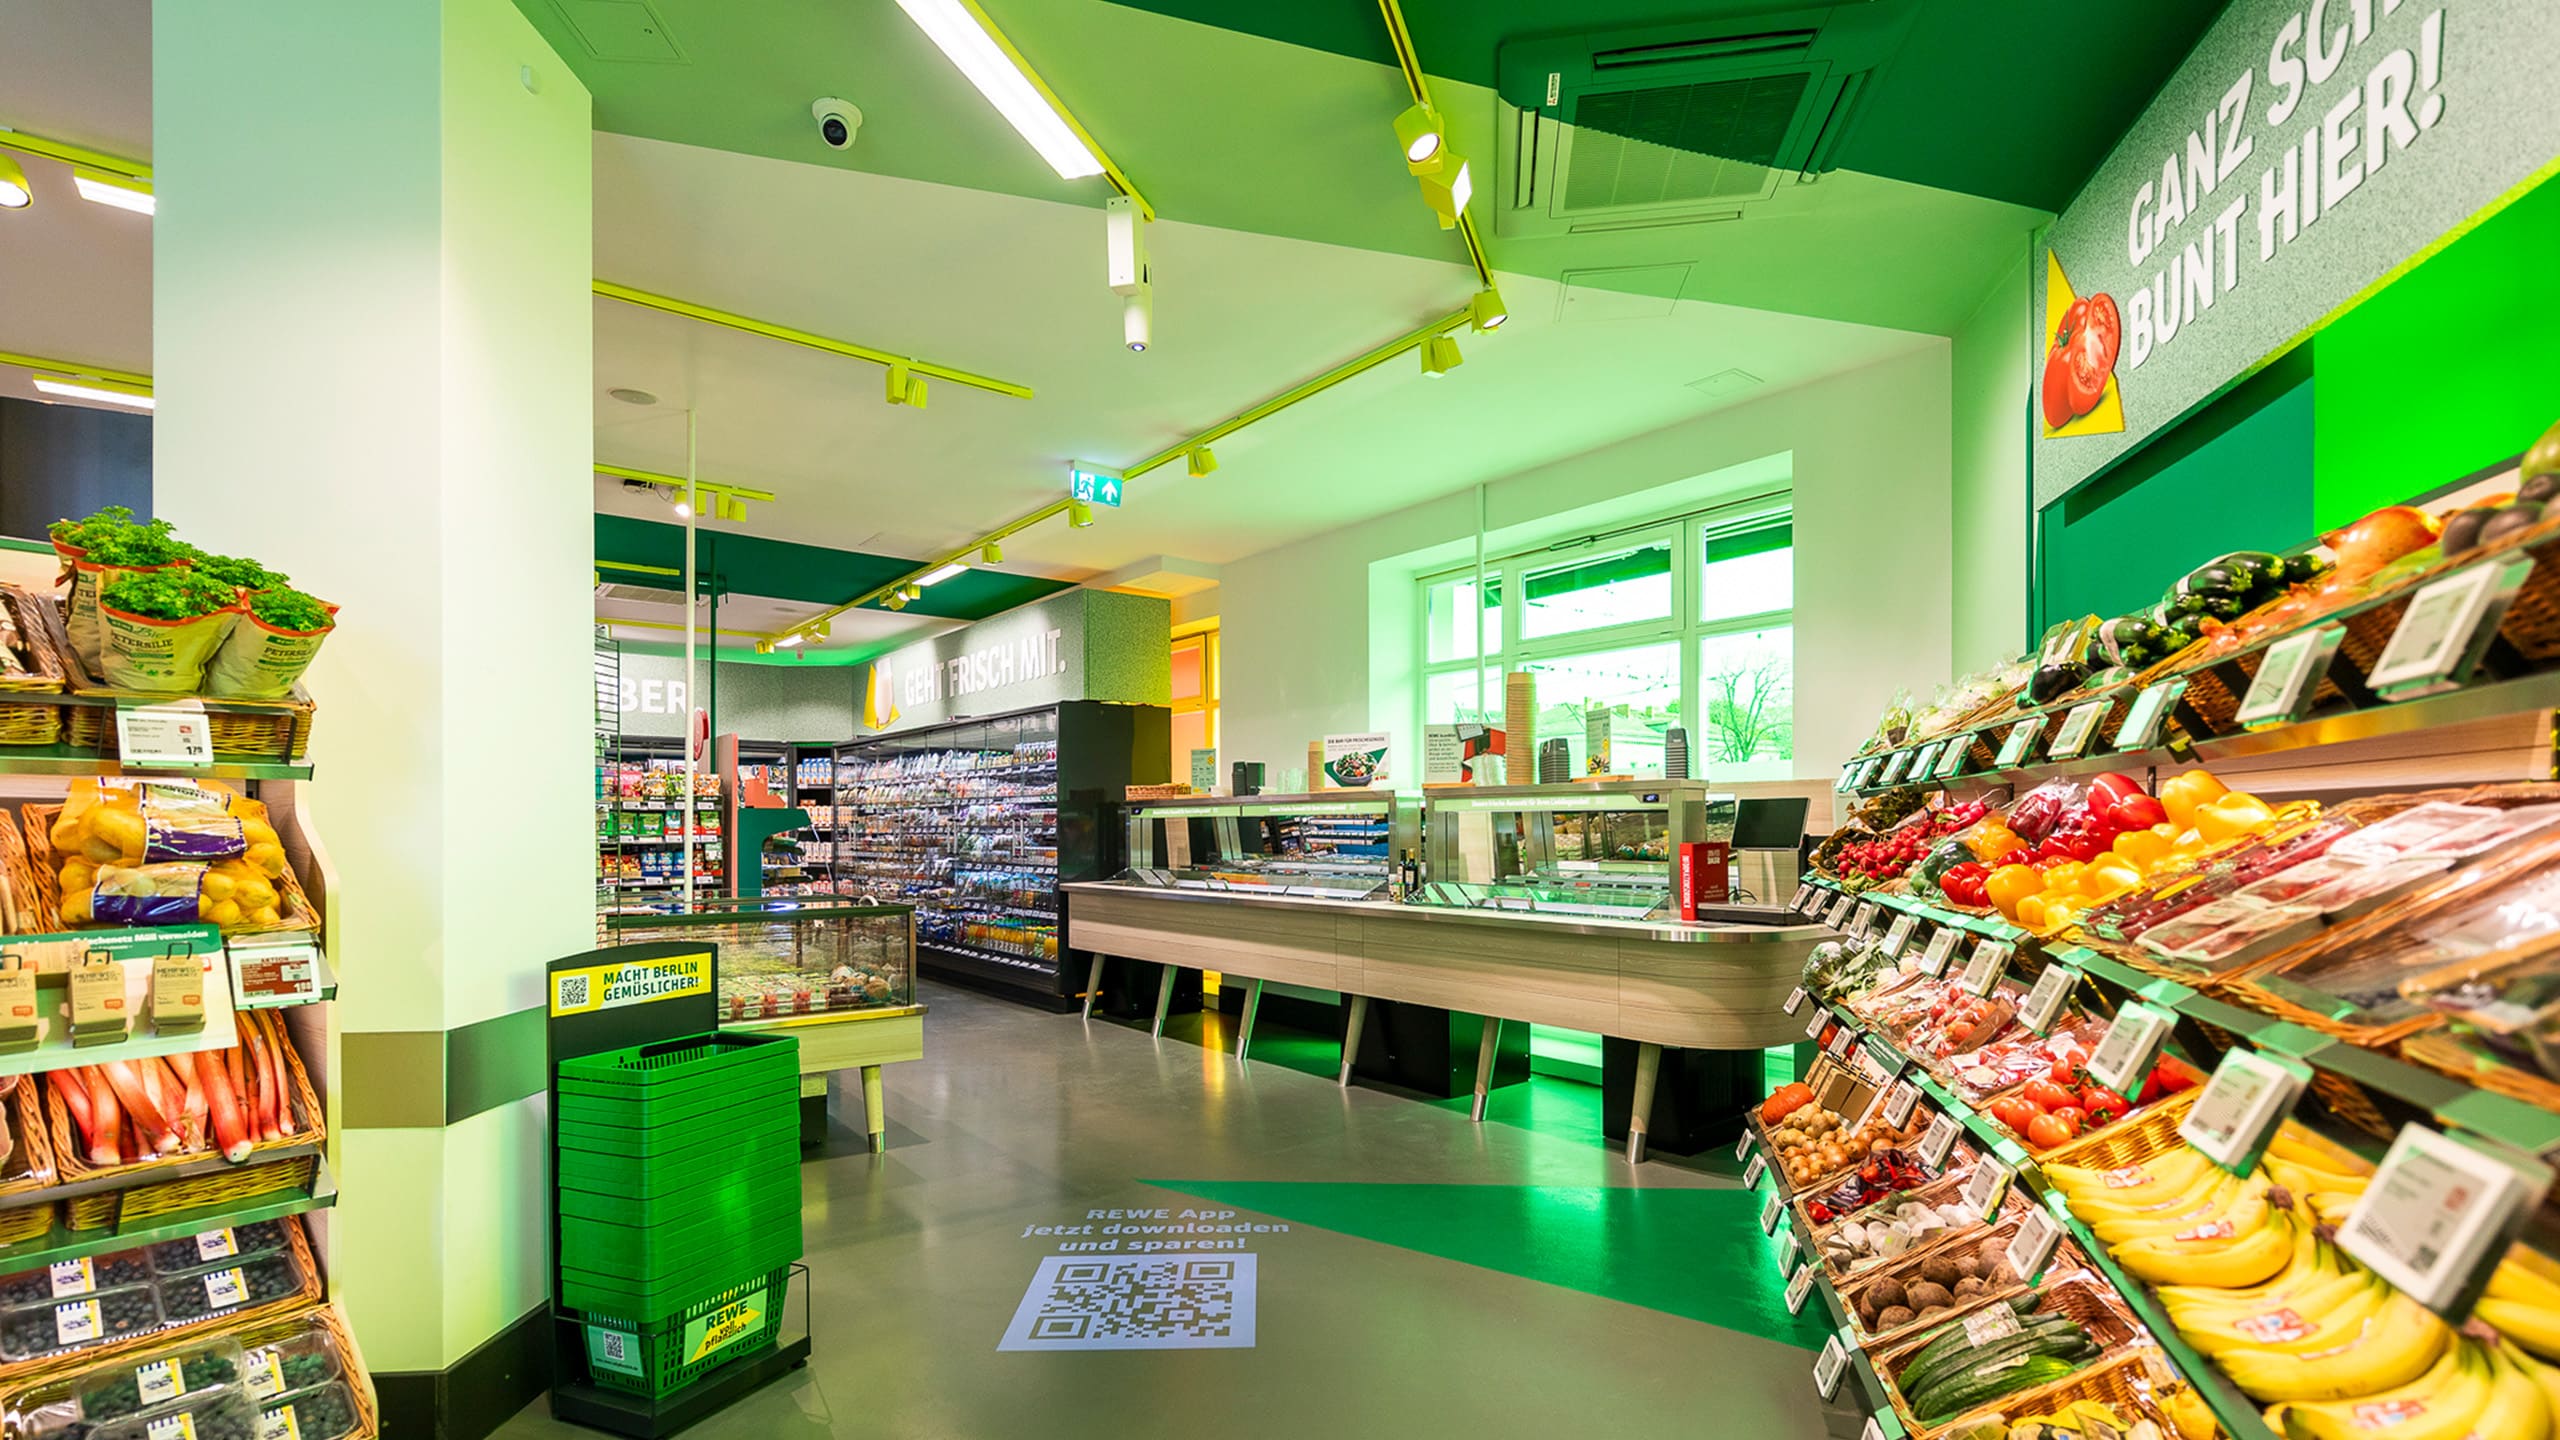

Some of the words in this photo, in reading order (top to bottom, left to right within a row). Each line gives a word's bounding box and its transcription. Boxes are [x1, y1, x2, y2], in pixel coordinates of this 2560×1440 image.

[2129, 67, 2254, 267] GANZ
[2266, 0, 2402, 126] SC
[2128, 194, 2248, 370] BUNT
[2258, 8, 2446, 263] HIER!
[905, 662, 945, 707] GEHT
[948, 642, 1015, 698] FRISCH
[1020, 628, 1068, 682] MIT.
[604, 967, 649, 985] MACHT
[653, 961, 698, 978] BERLIN
[604, 976, 699, 1001] GEMÜSLICHER!
[1086, 1209, 1170, 1219] REWE
[1178, 1208, 1236, 1221] App
[1021, 1224, 1094, 1238] jetzt
[1102, 1223, 1290, 1235] downloaden
[1058, 1239, 1118, 1251] und
[1127, 1237, 1247, 1252] sparen!
[706, 1300, 748, 1331] REWE
[720, 1320, 735, 1334] voll
[704, 1322, 747, 1351] pflanzlich
